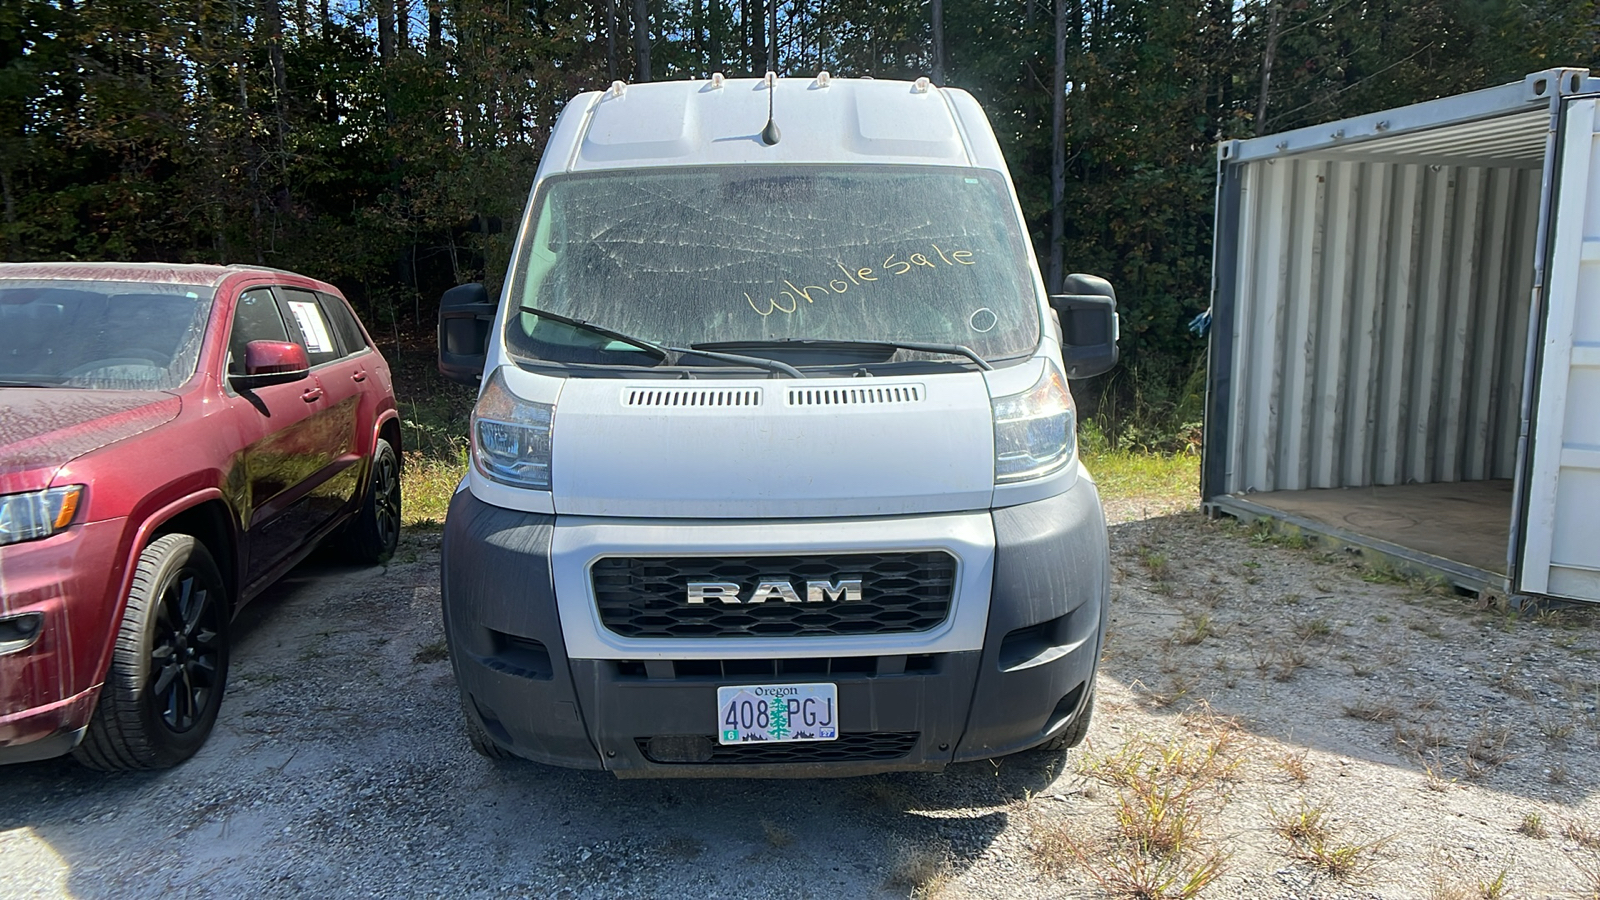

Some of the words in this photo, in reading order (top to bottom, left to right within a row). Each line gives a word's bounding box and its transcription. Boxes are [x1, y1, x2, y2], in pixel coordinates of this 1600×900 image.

[687, 579, 863, 604] RAM
[755, 686, 798, 698] Oregon
[725, 699, 770, 730] 408
[786, 697, 832, 727] PGJ
